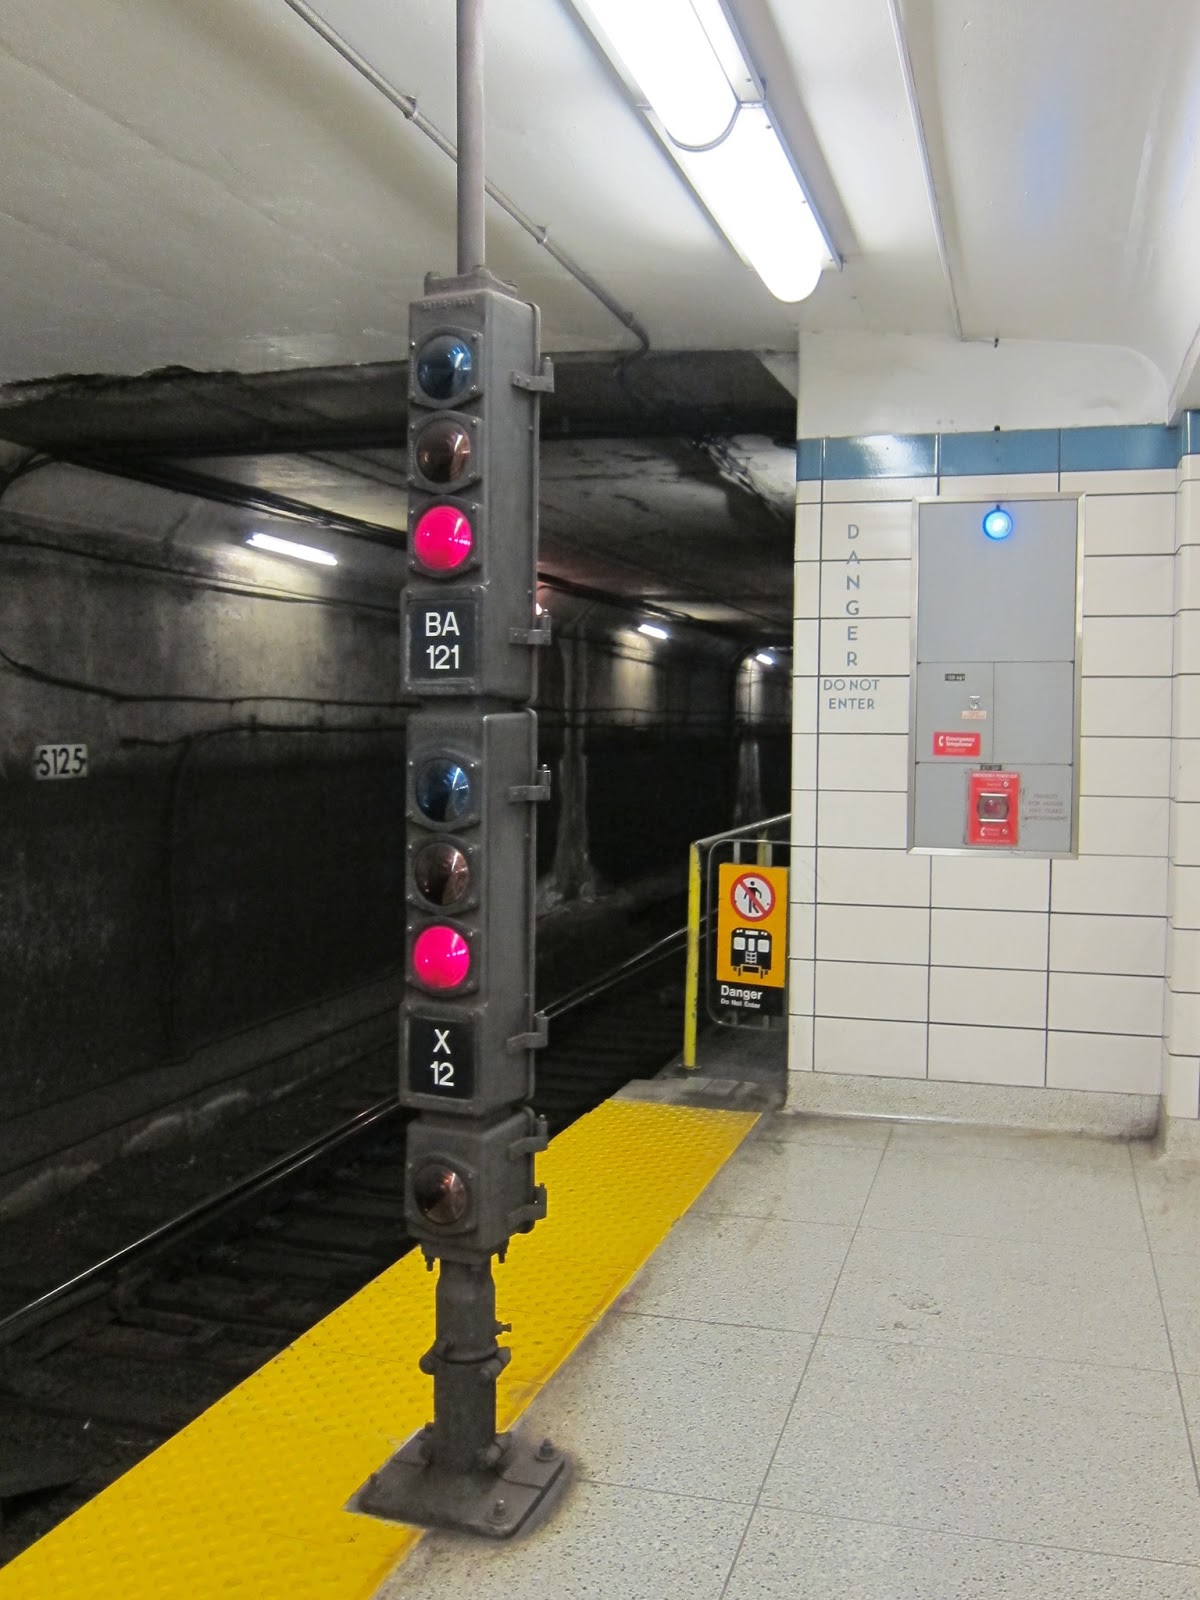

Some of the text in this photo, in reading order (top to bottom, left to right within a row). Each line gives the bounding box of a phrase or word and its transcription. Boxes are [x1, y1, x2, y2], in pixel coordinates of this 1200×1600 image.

[845, 523, 860, 667] DANGER
[425, 611, 460, 637] BA
[426, 644, 460, 670] 121
[823, 678, 880, 691] DO NOT
[828, 697, 875, 710] ENTER
[38, 747, 86, 777] S125
[720, 998, 761, 1009] Do Not Enter
[721, 985, 762, 1000] Danger
[432, 1028, 452, 1055] X
[430, 1060, 455, 1087] 12
